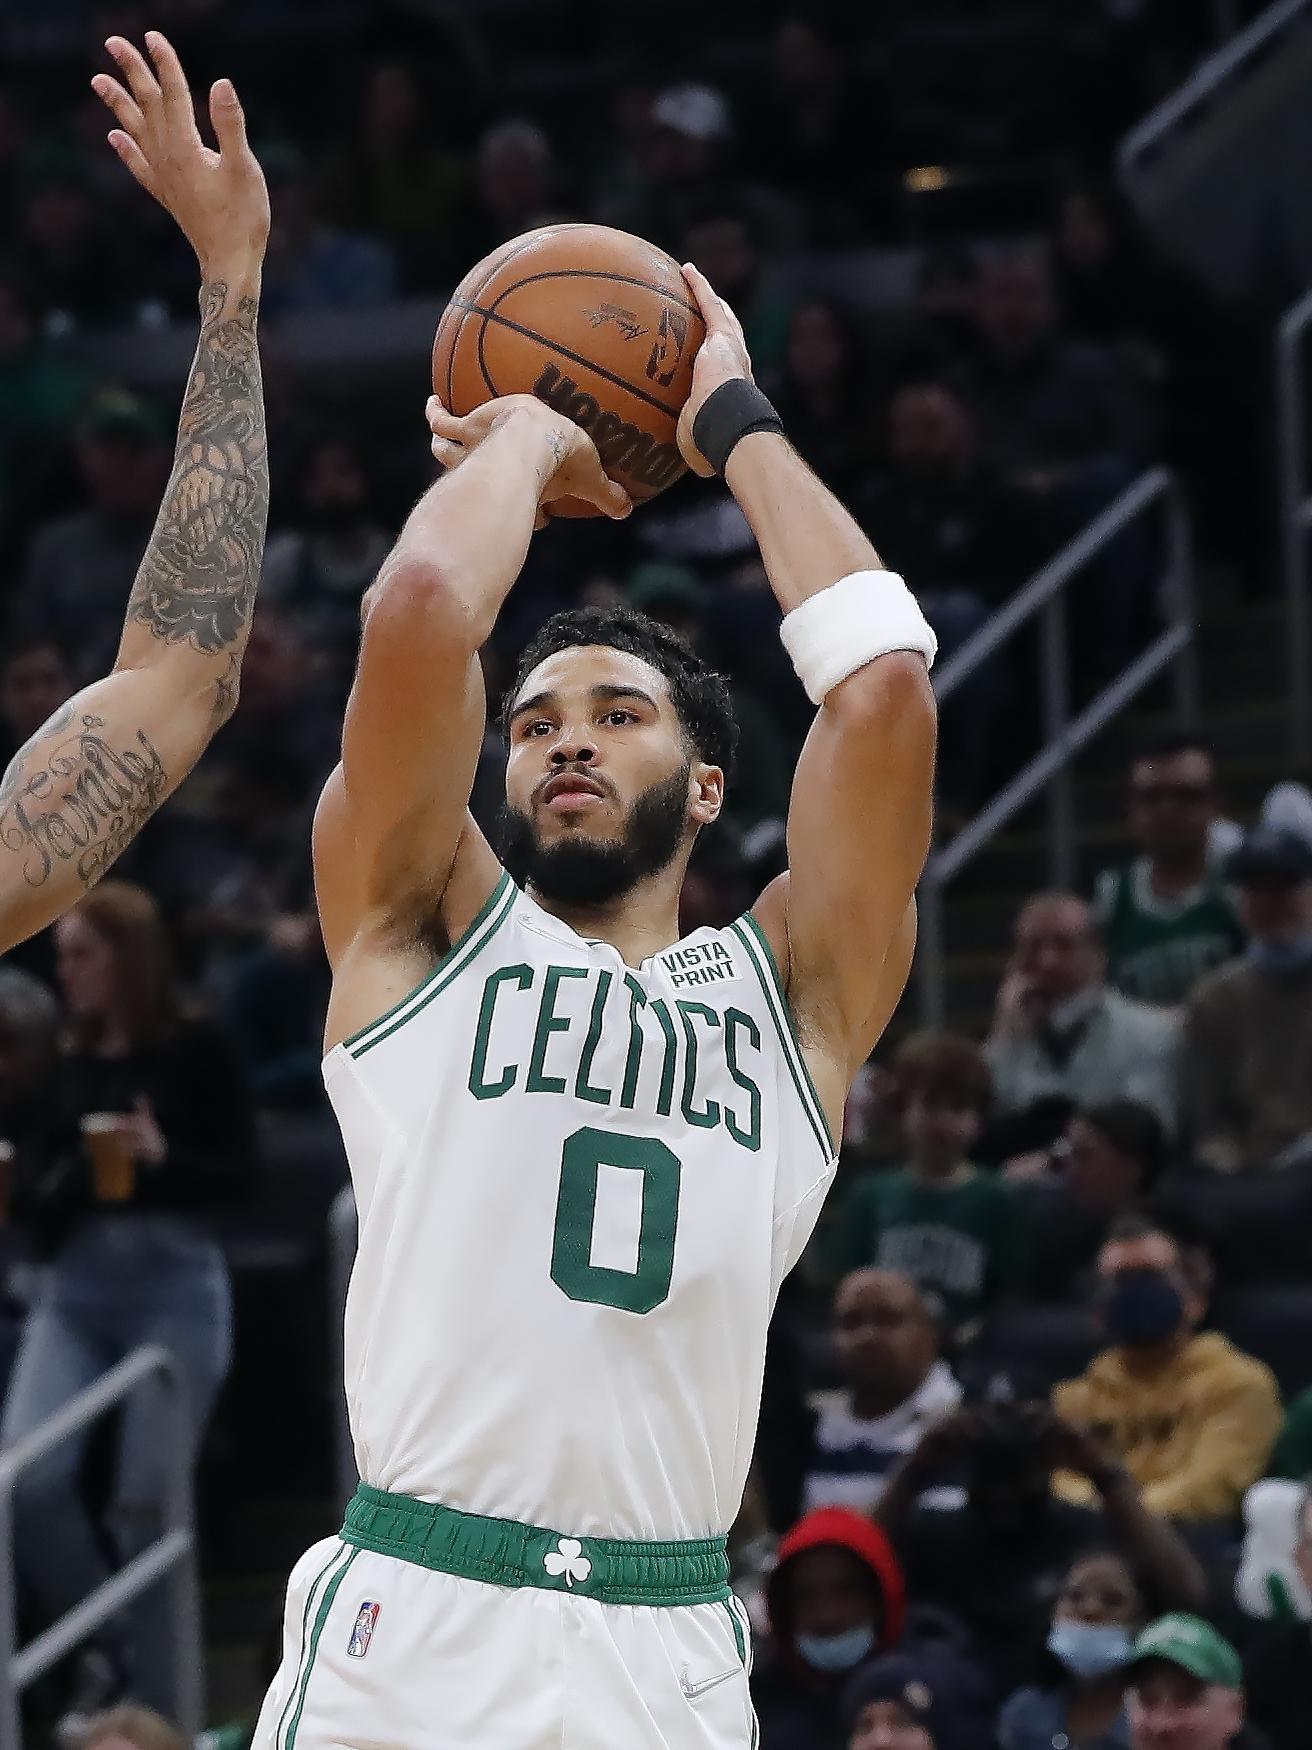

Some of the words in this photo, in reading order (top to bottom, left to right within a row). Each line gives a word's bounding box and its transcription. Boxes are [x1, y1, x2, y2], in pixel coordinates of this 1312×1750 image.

[661, 941, 730, 973] VISTA
[670, 960, 735, 988] PRINT
[468, 963, 762, 1152] CELTICS
[550, 1126, 682, 1315] 0
